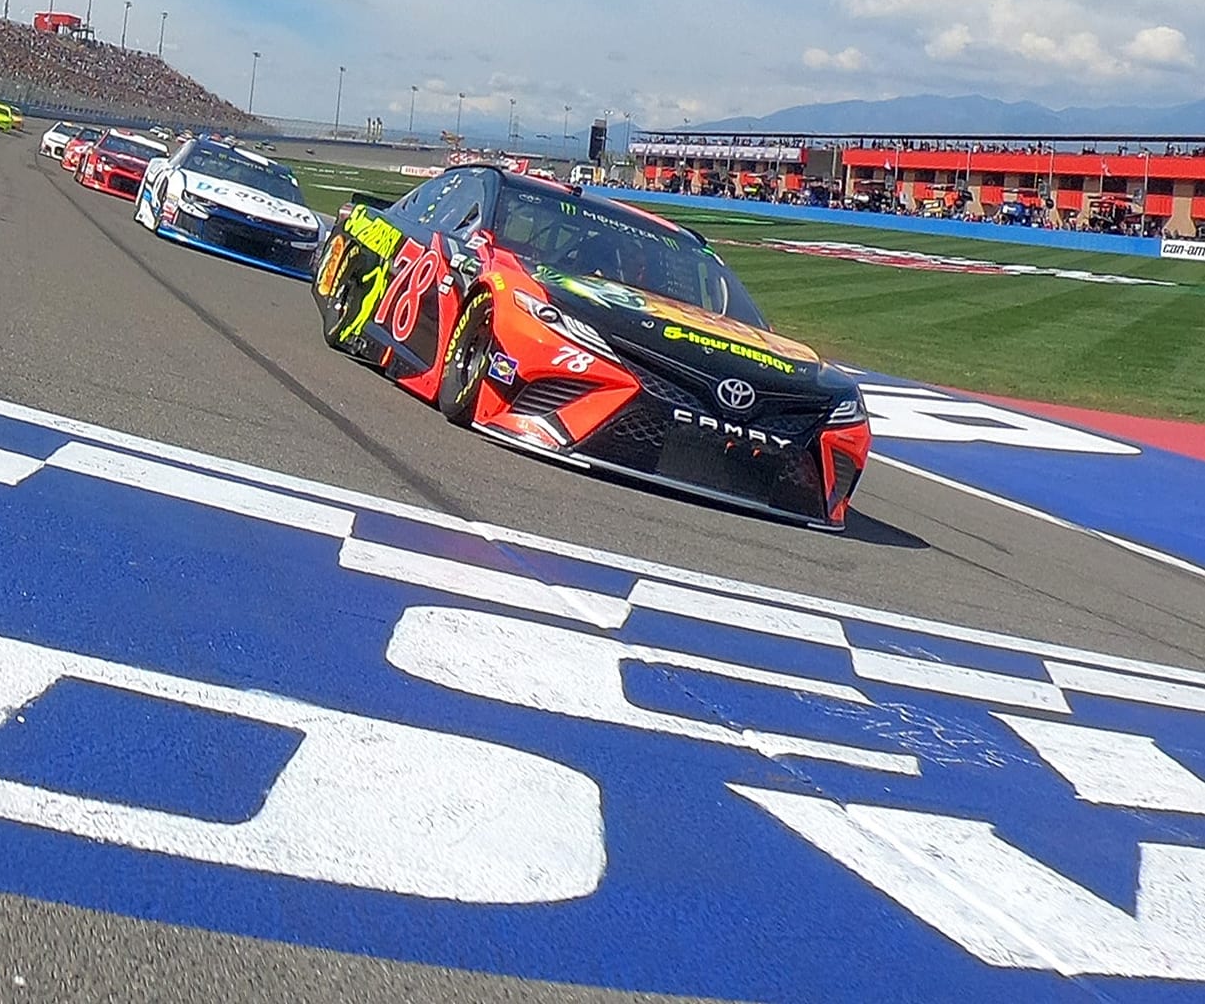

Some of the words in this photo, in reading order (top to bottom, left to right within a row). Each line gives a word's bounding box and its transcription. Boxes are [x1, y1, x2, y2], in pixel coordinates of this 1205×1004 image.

[195, 181, 228, 196] DC
[235, 190, 311, 224] SOLAR
[374, 237, 440, 342] 78
[662, 325, 729, 350] 5-hour
[551, 346, 596, 373] 78
[673, 408, 792, 449] CAMRY
